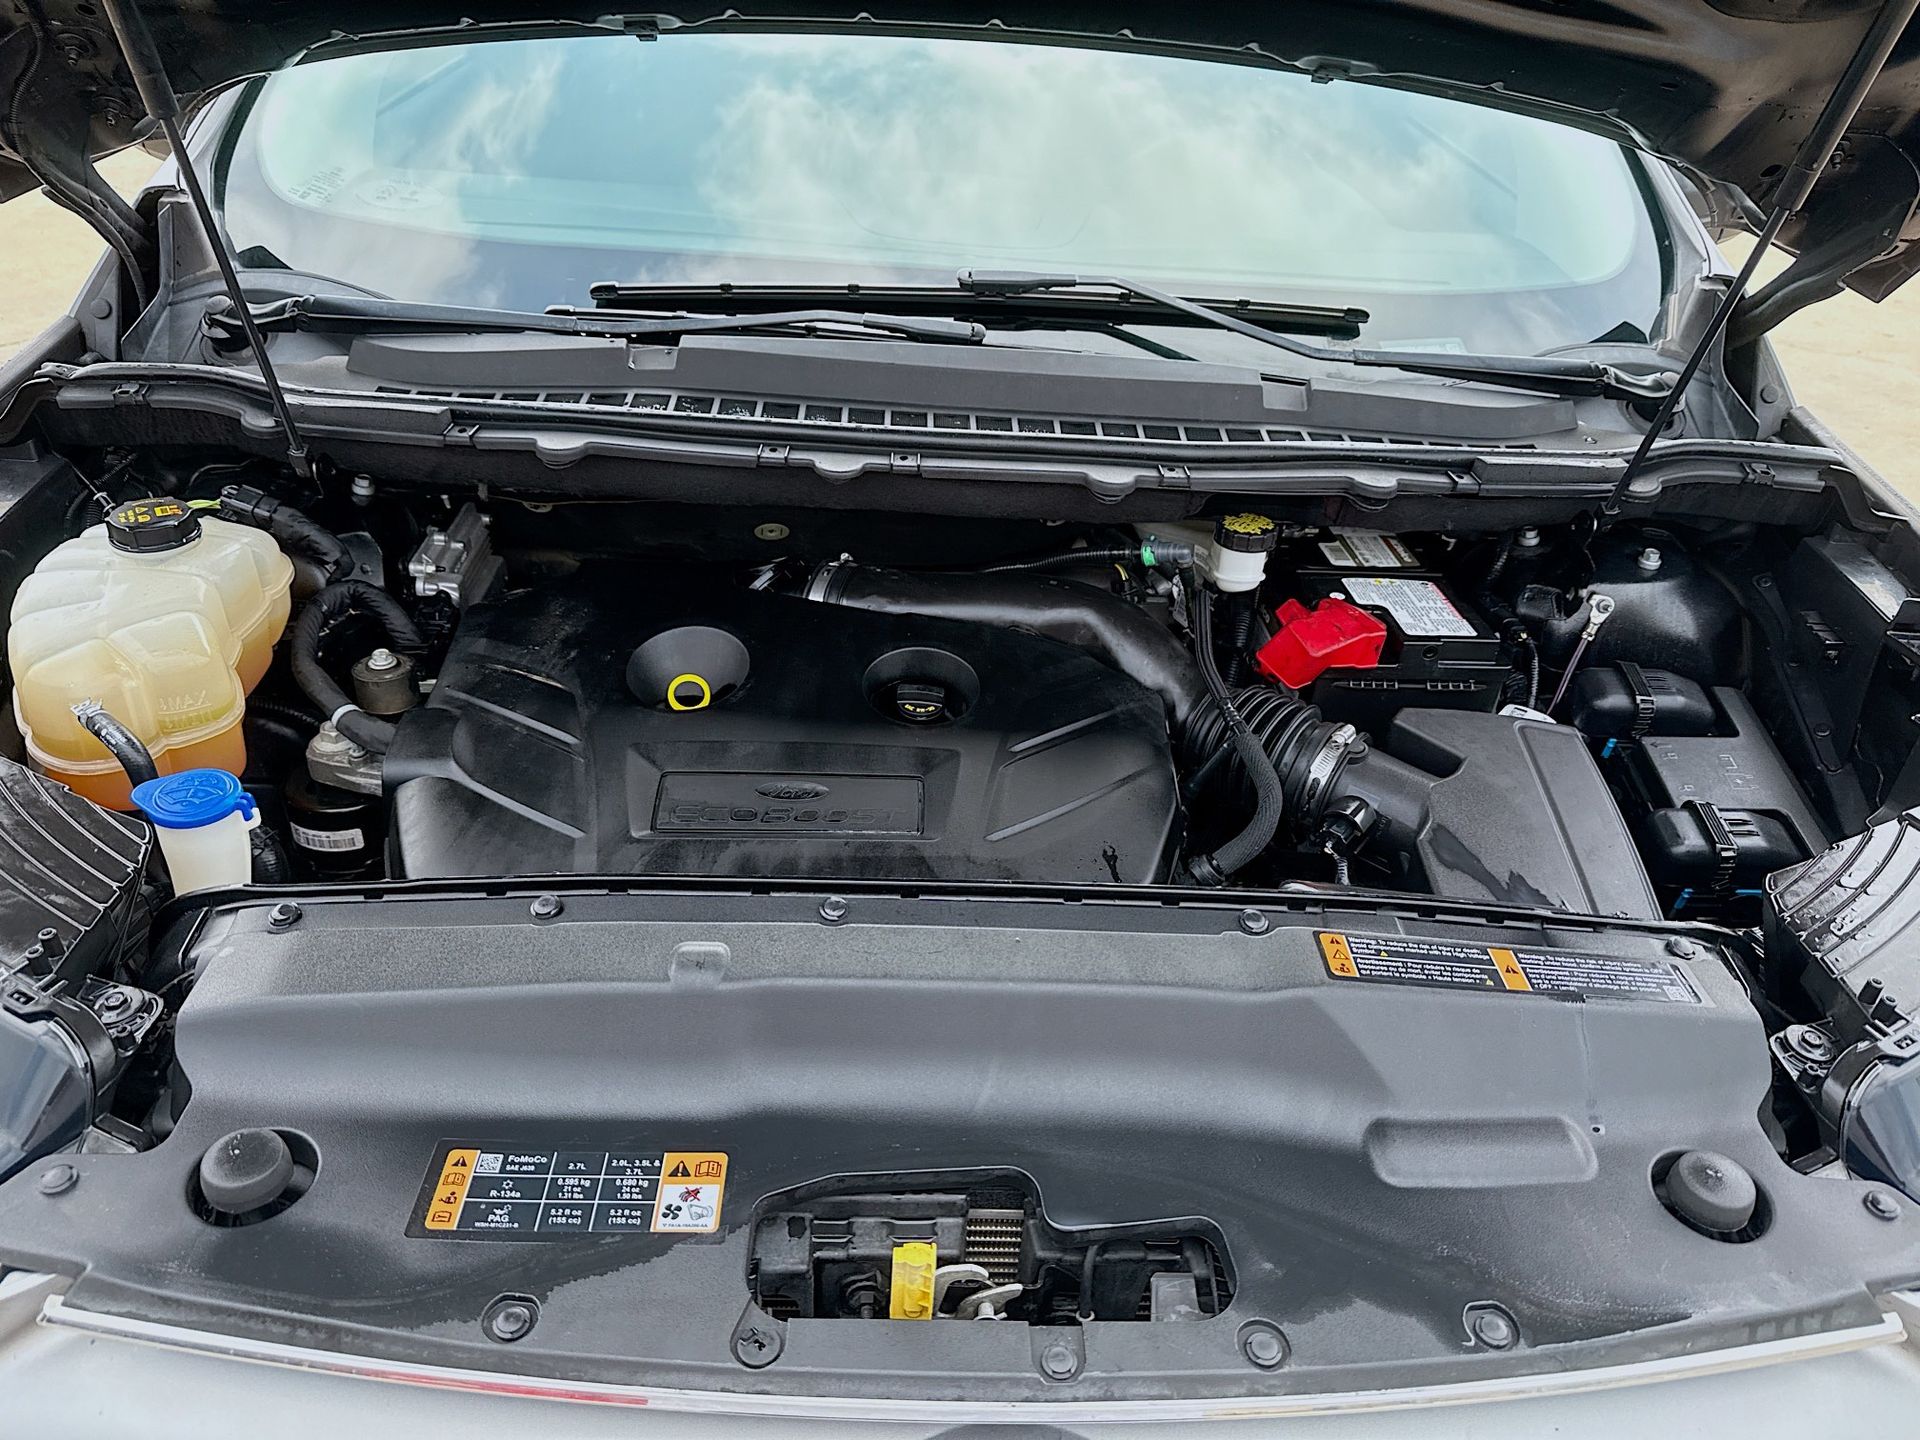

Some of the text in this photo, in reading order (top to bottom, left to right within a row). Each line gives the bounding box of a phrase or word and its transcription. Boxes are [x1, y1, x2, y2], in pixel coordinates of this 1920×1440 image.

[767, 783, 820, 799] Ford
[508, 1154, 547, 1163] FoMoCo
[611, 1159, 632, 1167] 2.0L,
[580, 1178, 591, 1187] kg
[638, 1179, 649, 1187] kg
[489, 1190, 521, 1198] R-134a
[550, 1208, 564, 1216] 5.2
[564, 1208, 571, 1216] fl
[488, 1214, 509, 1222] PAG
[548, 1217, 582, 1225] (155 cc)
[608, 1217, 641, 1225] (155 cc)
